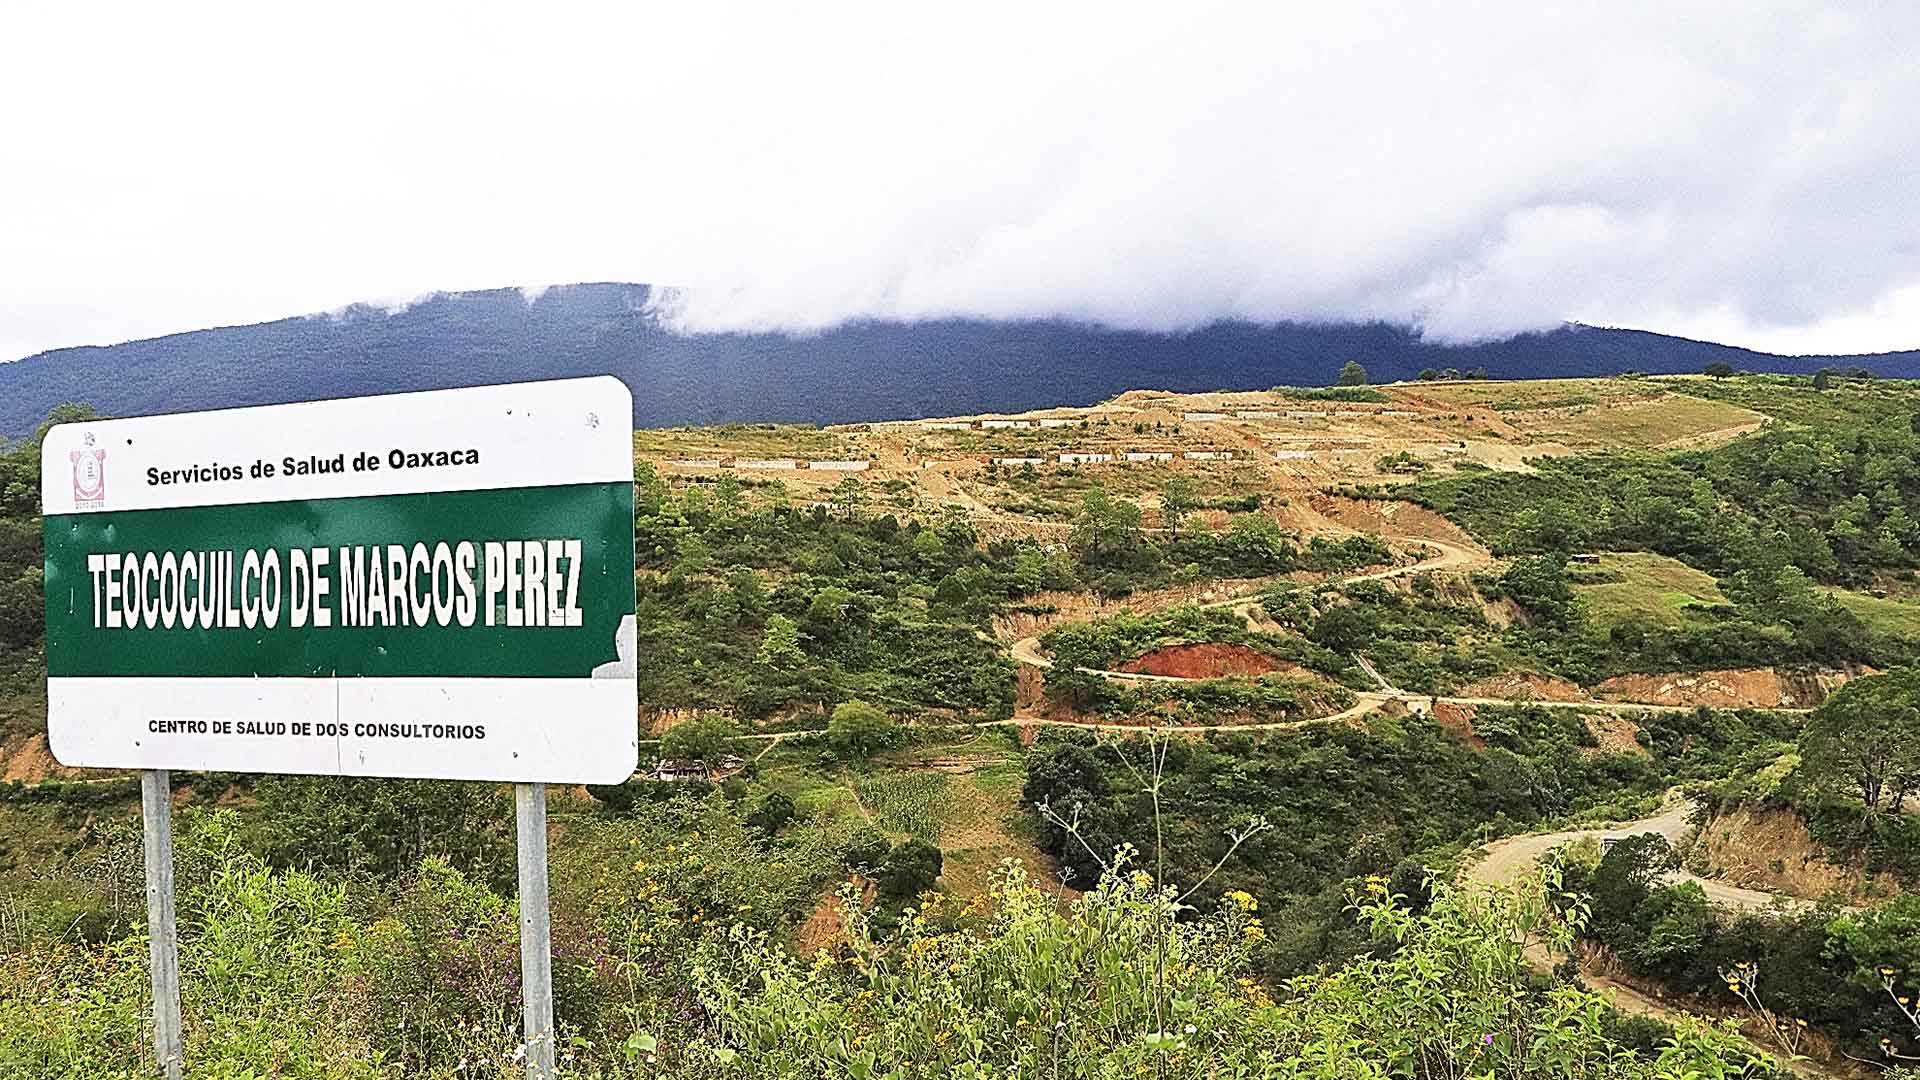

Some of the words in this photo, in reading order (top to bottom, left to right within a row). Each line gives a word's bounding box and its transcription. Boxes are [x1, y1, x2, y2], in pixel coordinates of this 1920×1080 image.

[147, 466, 243, 486] Servicios
[250, 460, 279, 479] de
[283, 456, 345, 477] Salud
[353, 452, 381, 472] de
[388, 448, 479, 470] Oaxaca
[87, 547, 281, 630] TEOCOCUILCO
[290, 546, 332, 628] DE
[339, 541, 477, 628] MARCOS
[484, 539, 583, 627] PEREZ
[148, 720, 208, 734] CENTRO
[213, 720, 232, 735] DE
[236, 721, 286, 736] SALUD
[292, 722, 311, 736] DE
[316, 723, 349, 737] DOS
[355, 723, 486, 740] CONSULTORIOS
